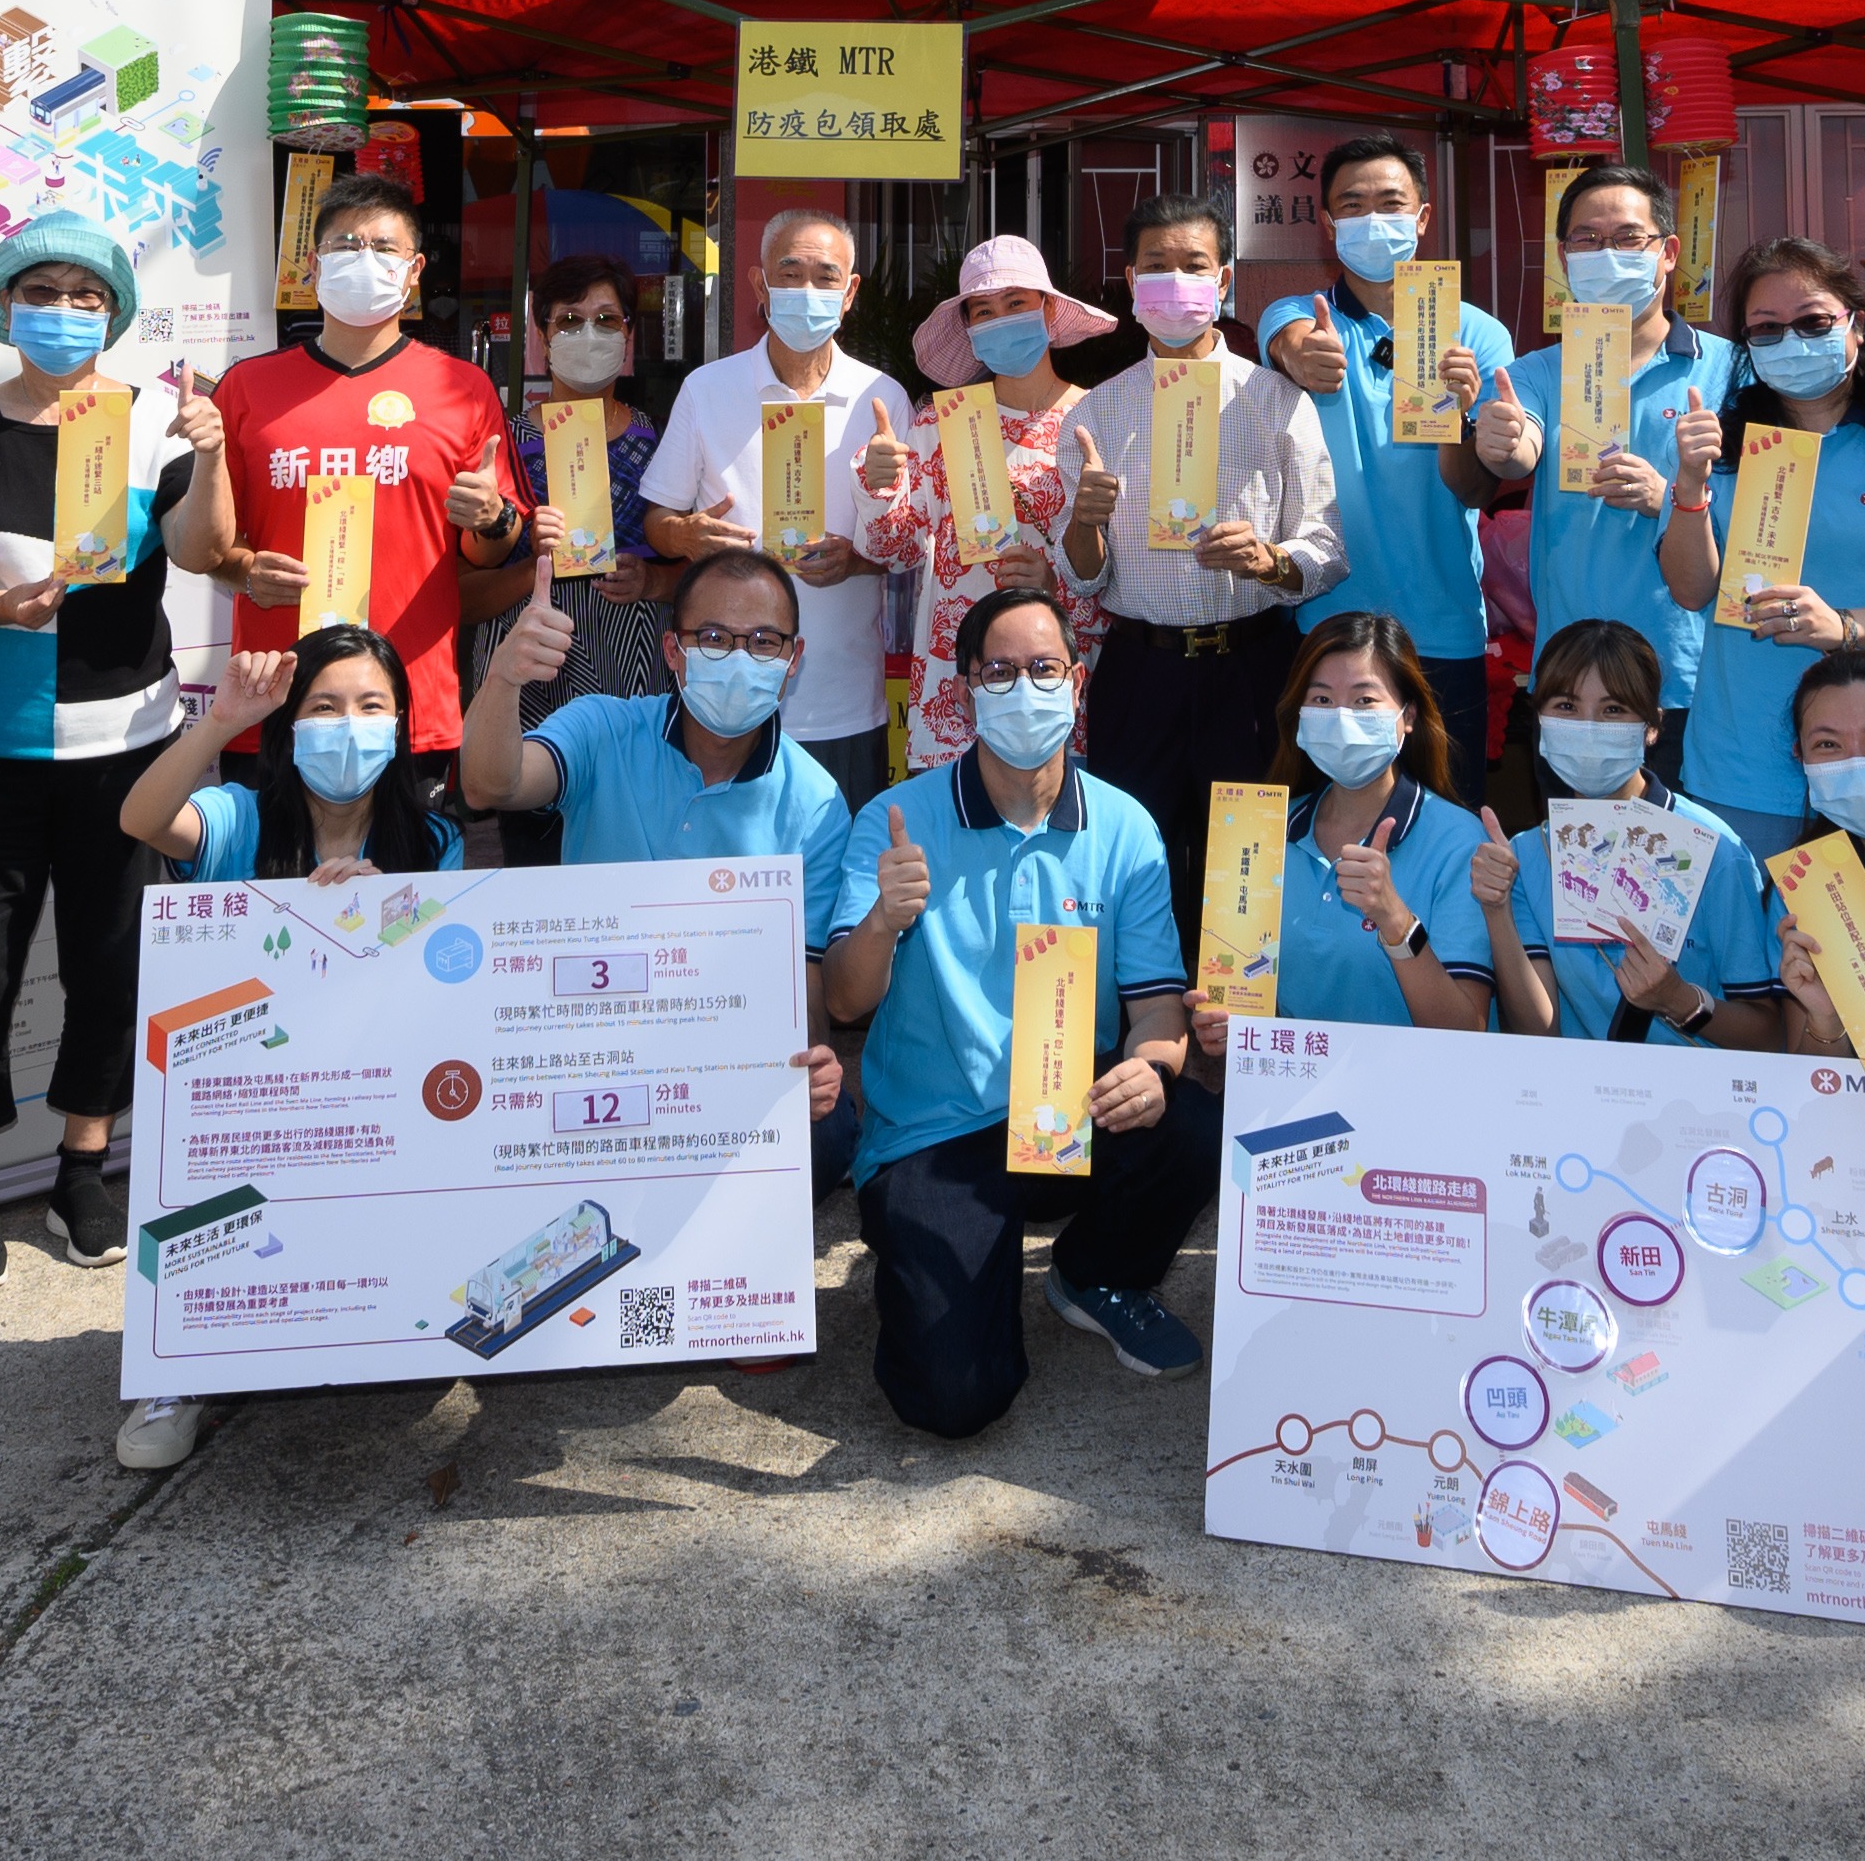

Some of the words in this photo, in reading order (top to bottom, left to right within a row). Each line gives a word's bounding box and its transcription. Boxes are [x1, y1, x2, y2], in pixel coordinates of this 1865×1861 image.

[747, 44, 820, 79] 港鐵
[838, 45, 896, 77] MTR
[745, 108, 945, 139] 防疫包領取處
[1253, 194, 1318, 226] 議員
[494, 317, 509, 331] 拉
[182, 332, 257, 344] mtrnorthernlink.hk
[269, 444, 410, 490] 新田鄉
[739, 869, 793, 888] MTR
[152, 891, 249, 920] 北環綫
[1077, 901, 1105, 913] MTR
[151, 922, 237, 945] 連繫未來
[492, 915, 620, 936] 往來古洞站至上水站
[654, 947, 688, 965] 分鐘
[492, 954, 543, 974] 只需約
[591, 960, 610, 990] 3
[654, 966, 700, 979] minutes
[493, 993, 747, 1021] (現時繁忙時間的路面車程需時約15分鐘)
[173, 1018, 226, 1048] 未來出行
[229, 1002, 269, 1027] 更便捷
[172, 1051, 208, 1069] MOBILITY
[208, 1045, 223, 1056] FOR
[224, 1039, 239, 1050] THE
[239, 1028, 267, 1046] FUTURE
[173, 1046, 194, 1059] MORE
[195, 1028, 239, 1051] CONNECTED
[1237, 1026, 1330, 1057] 北環綫
[491, 1049, 635, 1073] 往來錦上路站至古洞站
[1235, 1056, 1318, 1080] 連繫未來
[655, 1082, 690, 1101] 分鐘
[1732, 1079, 1758, 1094] 羅湖
[491, 1090, 543, 1111] 只需約
[582, 1092, 622, 1125] 12
[655, 1102, 702, 1115] minutes
[492, 1129, 782, 1160] (現時繁忙時間的路面車程需時約60至80分鐘)
[1257, 1147, 1308, 1172] 未來社區
[1312, 1137, 1350, 1159] 更蓬勃
[1256, 1170, 1277, 1182] MORE
[1278, 1161, 1322, 1178] COMMUNITY
[1509, 1153, 1547, 1170] 落馬洲
[1256, 1179, 1286, 1192] VITALITY
[1286, 1174, 1301, 1184] FOR
[1302, 1171, 1317, 1181] THE
[1317, 1165, 1344, 1178] FUTURE
[1505, 1169, 1519, 1179] Lok
[1520, 1170, 1530, 1179] Ma
[1372, 1174, 1478, 1199] 北環綫鐵路走綫
[1706, 1182, 1748, 1209] 古洞
[1831, 1210, 1858, 1225] 上水
[165, 1226, 220, 1258] 未來生活
[222, 1209, 263, 1235] 更環保
[1820, 1226, 1851, 1237] Sheung
[163, 1265, 189, 1280] LIVING
[190, 1259, 205, 1270] FOR
[206, 1252, 221, 1264] THE
[221, 1240, 250, 1259] FUTURE
[164, 1255, 186, 1269] MORE
[187, 1236, 236, 1261] SUSTAINABLE
[1619, 1245, 1662, 1267] 新田
[1629, 1269, 1643, 1277] San
[1644, 1269, 1656, 1277] Tin
[687, 1276, 748, 1293] 掃描二維碼
[182, 1296, 289, 1314] 可持續發展為重要考慮
[687, 1290, 796, 1310] 了解更多及提出建議
[688, 1329, 806, 1349] mtrnorthernlink.hk
[1486, 1387, 1528, 1409] 凹頭
[1274, 1458, 1312, 1477] 天水圍
[1352, 1456, 1378, 1472] 朗屏
[1270, 1475, 1283, 1485] Tin
[1284, 1476, 1300, 1487] Shui
[1301, 1478, 1315, 1488] Wai
[1346, 1473, 1365, 1484] Long
[1366, 1474, 1384, 1486] Ping
[1433, 1475, 1460, 1492] 元朗
[1426, 1491, 1445, 1502] Yuen
[1446, 1493, 1466, 1505] Long
[1487, 1487, 1551, 1536] 錦上路
[1499, 1516, 1528, 1538] Sheung
[1527, 1529, 1547, 1545] Road
[1646, 1519, 1688, 1539] 屯馬綫
[1640, 1536, 1661, 1547] Tuen
[1662, 1539, 1674, 1549] Ma
[1675, 1541, 1693, 1552] Line
